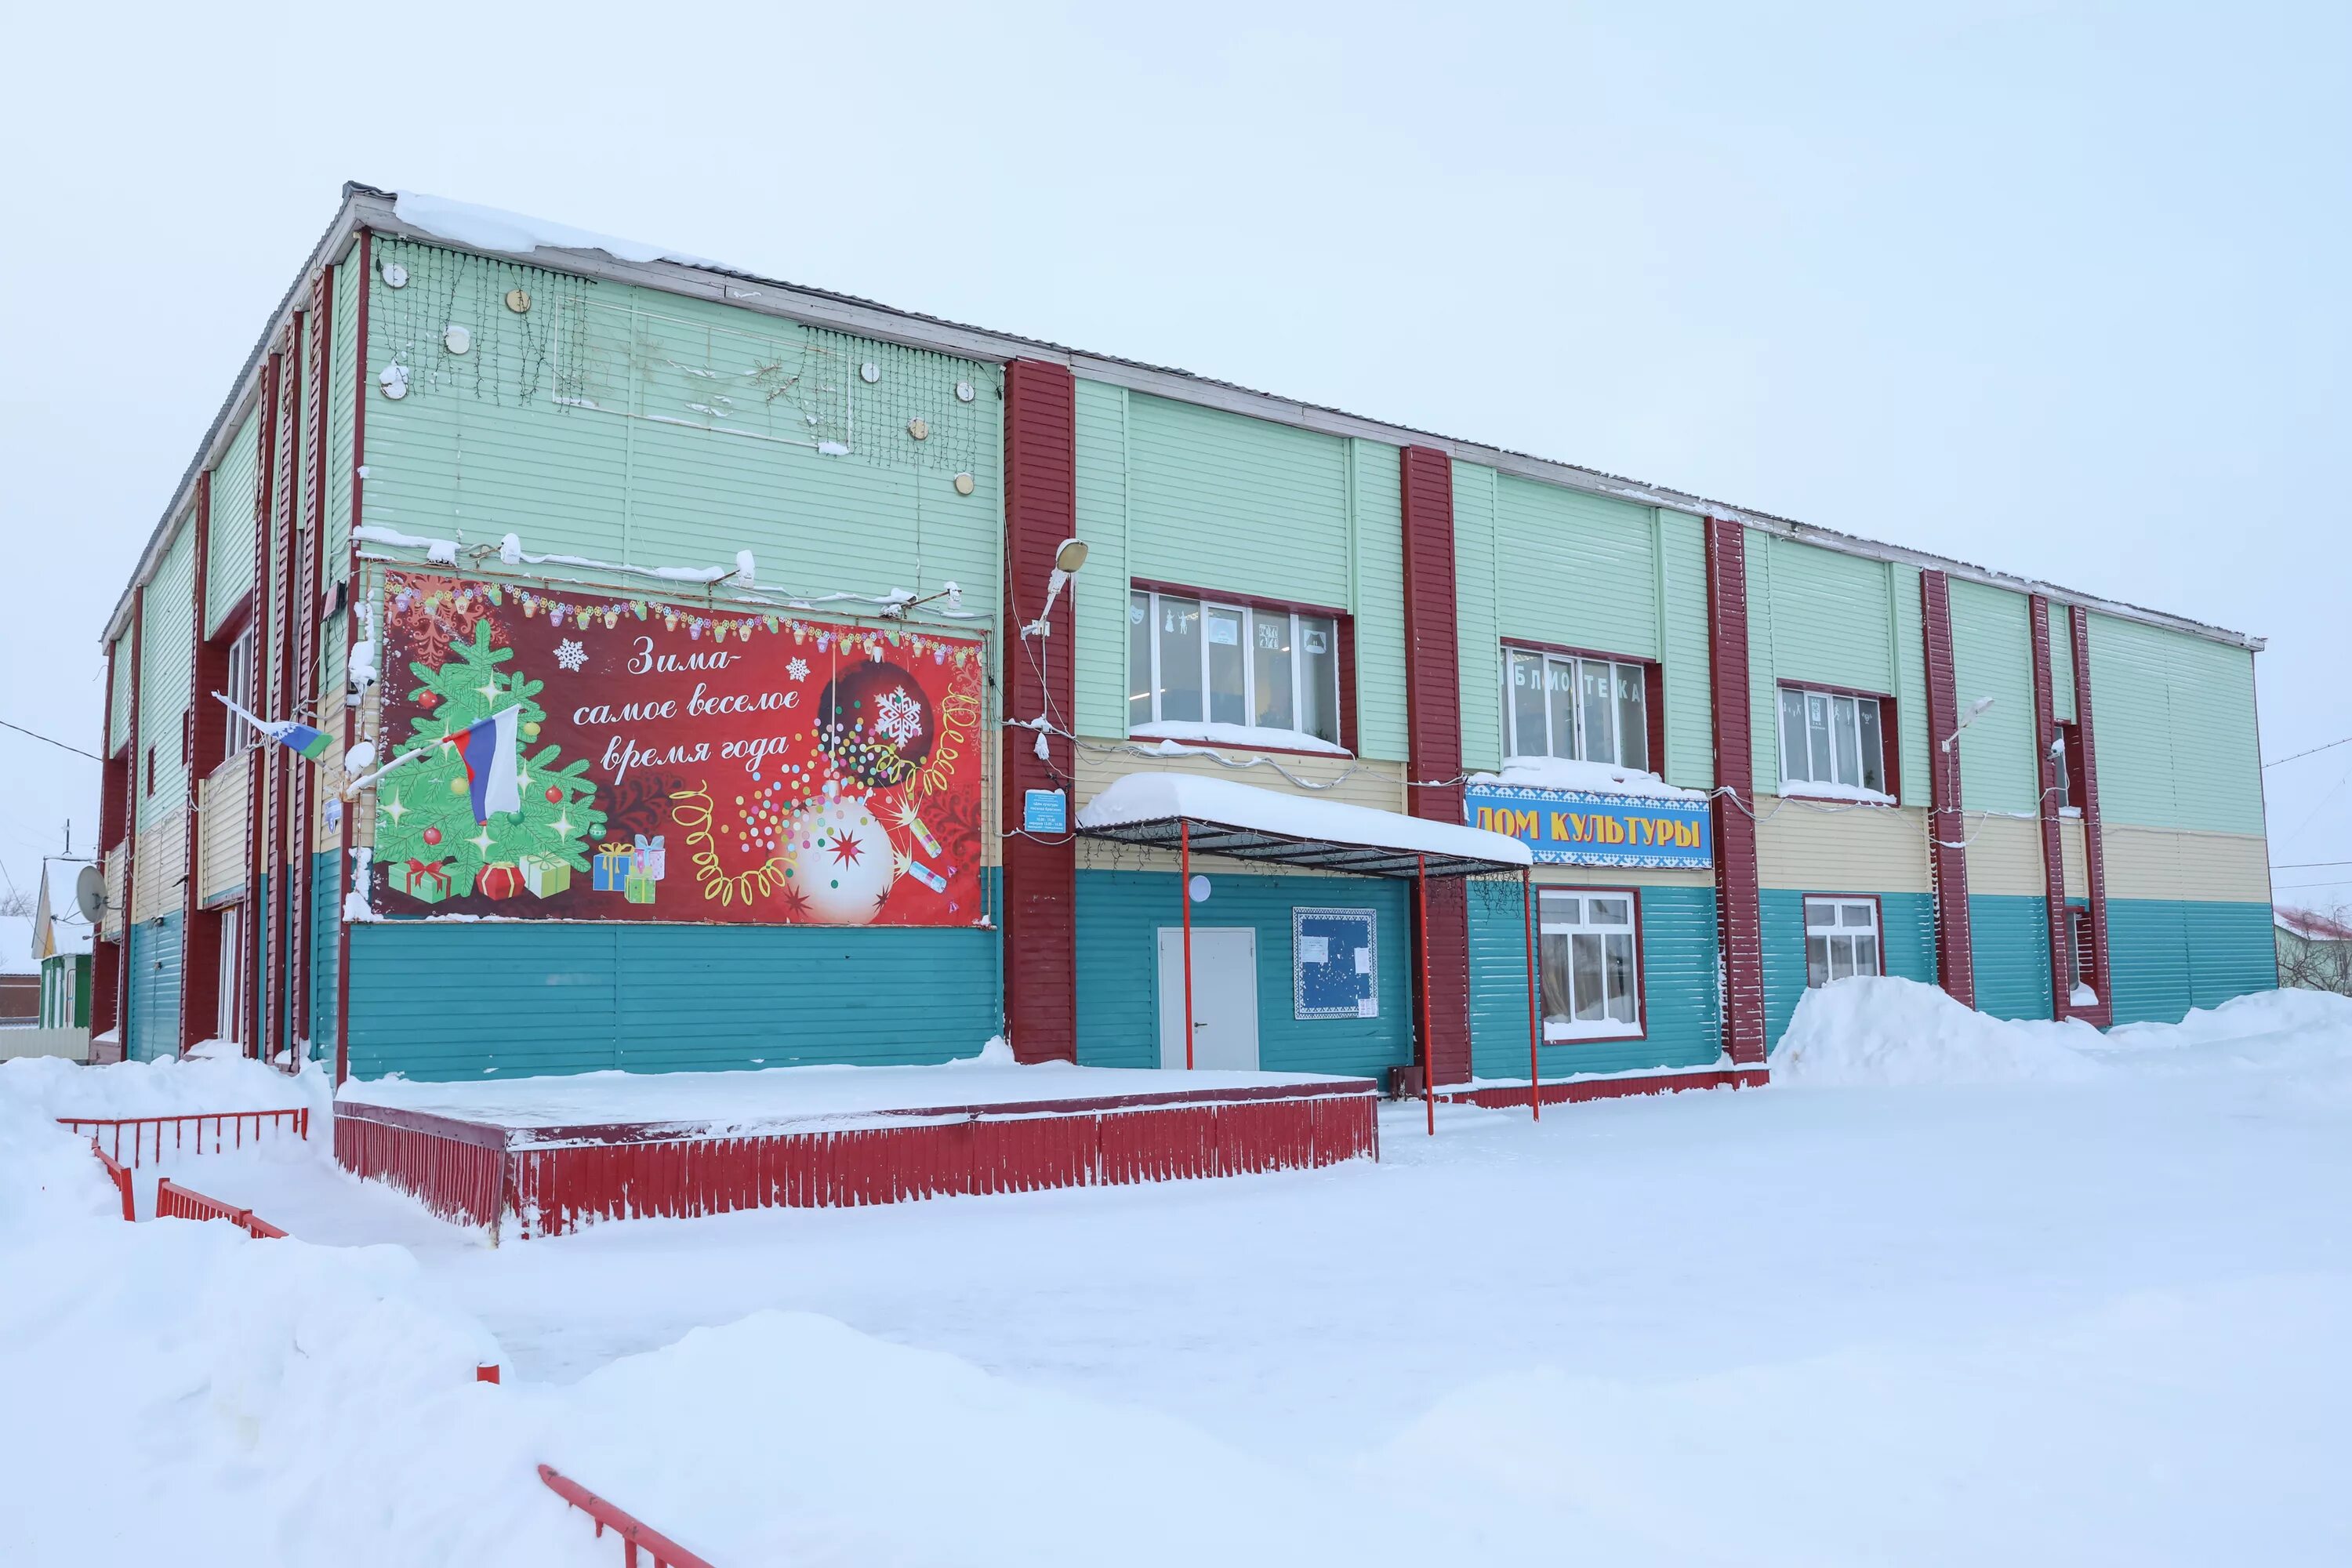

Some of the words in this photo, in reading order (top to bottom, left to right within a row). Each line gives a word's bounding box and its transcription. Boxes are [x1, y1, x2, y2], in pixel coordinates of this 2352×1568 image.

[1501, 664, 1641, 702] БЛИОТЕКА
[573, 699, 677, 726] самое
[686, 683, 800, 717] веселое
[600, 735, 711, 786] время
[720, 734, 790, 772] года
[1476, 807, 1541, 840] ДОМ
[1551, 811, 1701, 848] КУЛЬТУРЫ
